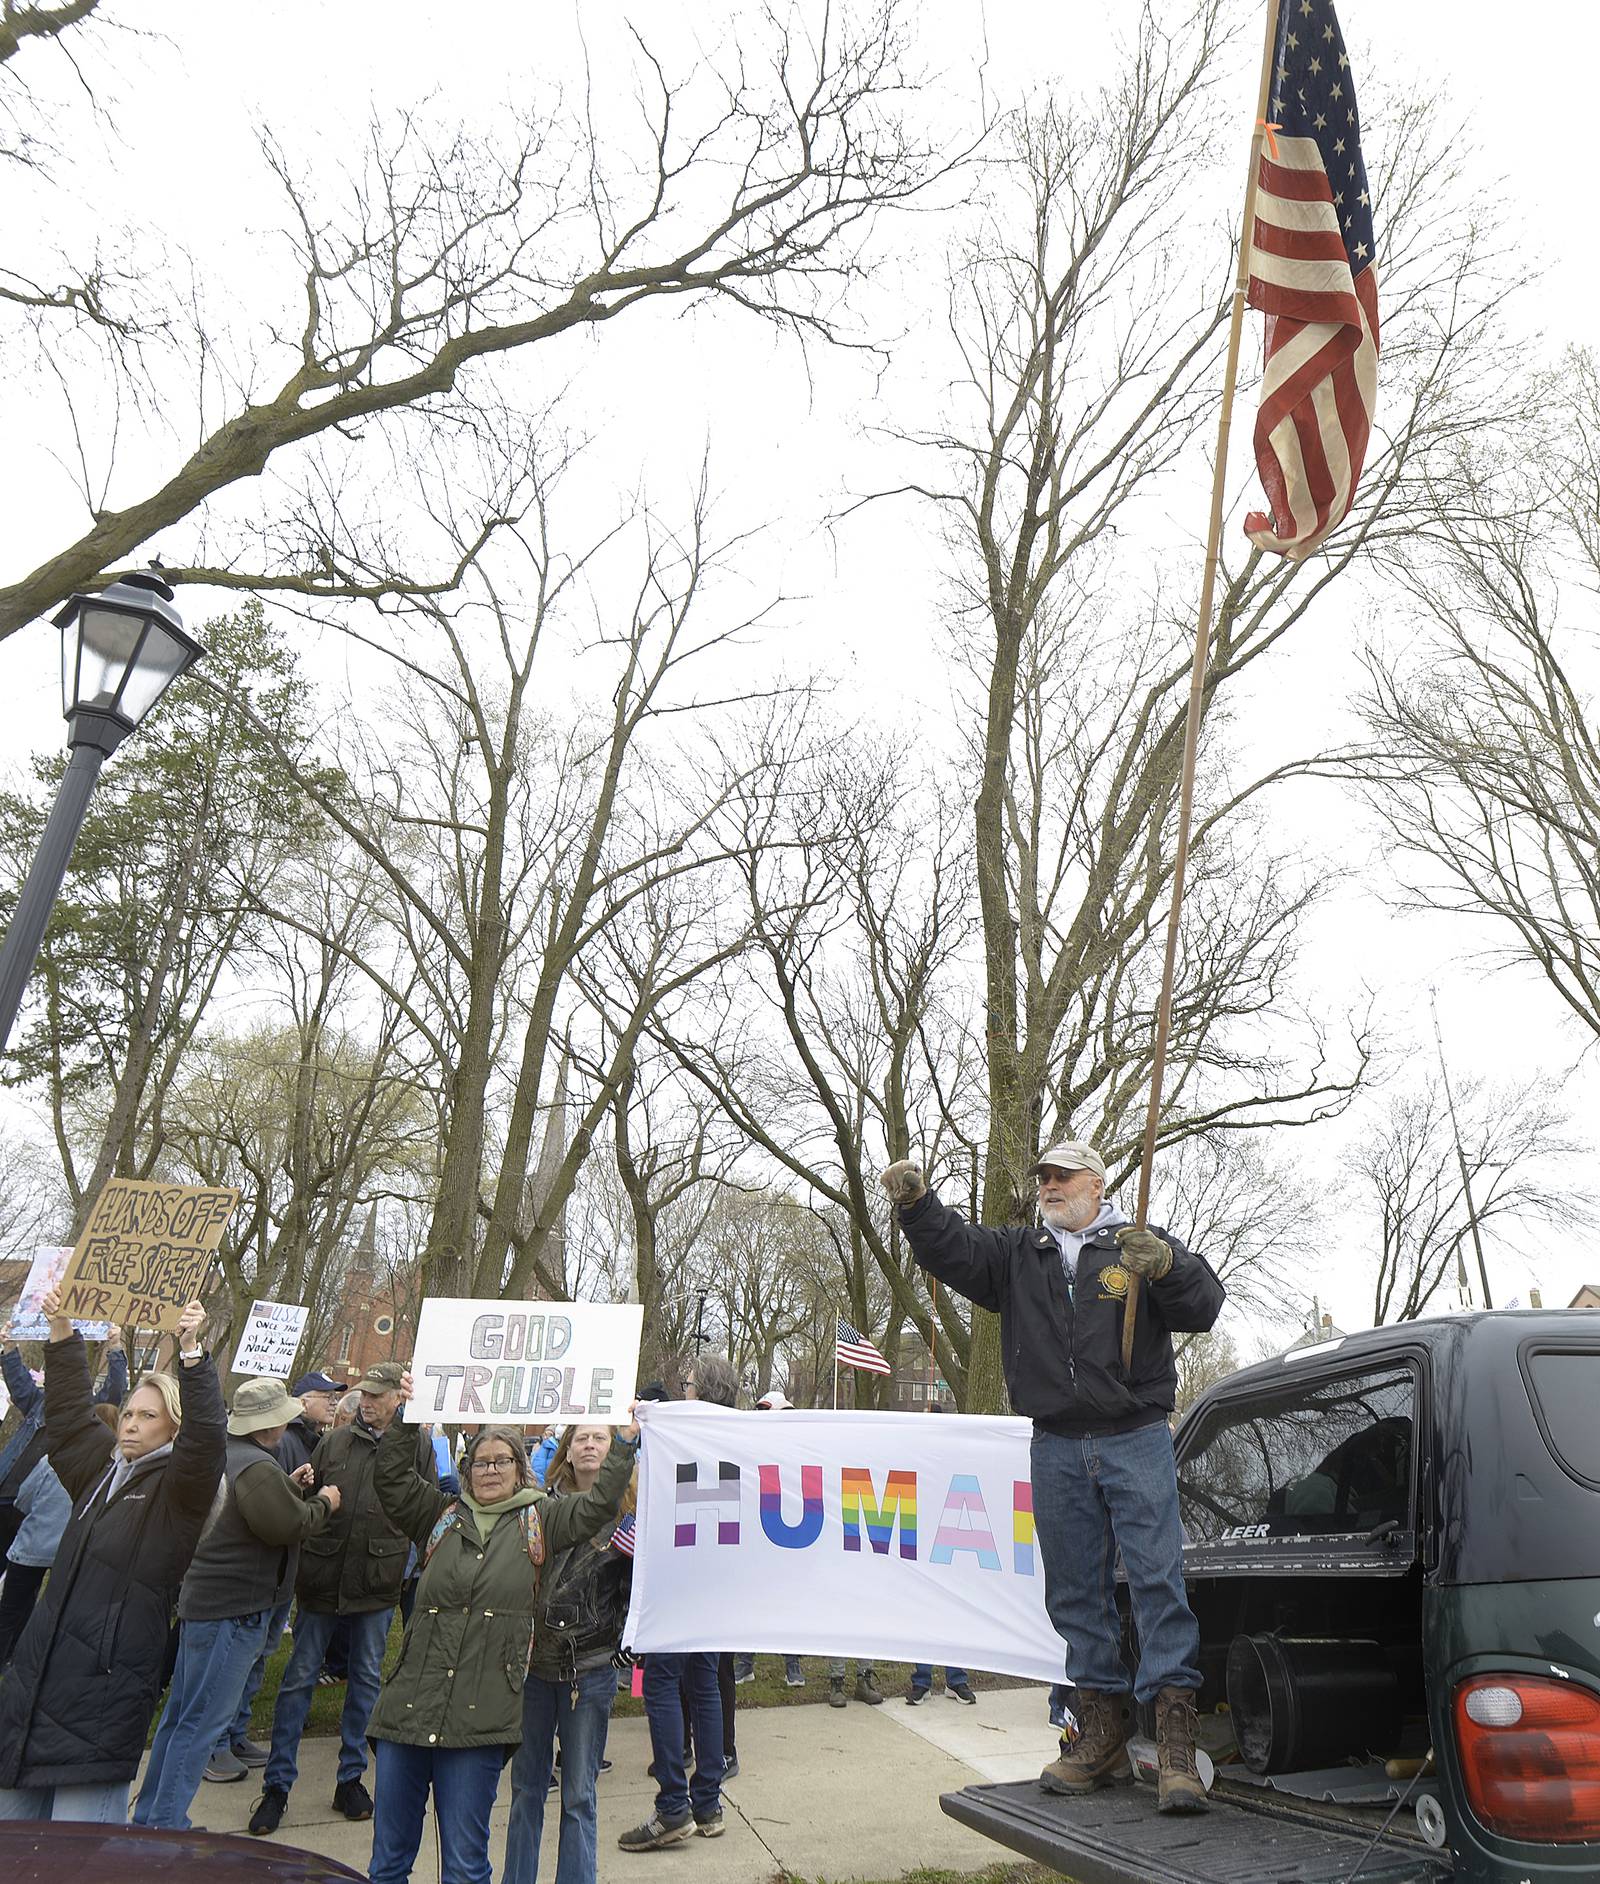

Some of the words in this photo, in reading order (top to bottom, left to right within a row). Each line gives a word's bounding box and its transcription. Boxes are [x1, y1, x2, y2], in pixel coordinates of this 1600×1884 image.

[91, 1187, 183, 1237] HANDS
[170, 1193, 233, 1244] OFF
[74, 1235, 143, 1285] FREE
[128, 1242, 215, 1307] SPEECH
[63, 1283, 112, 1316] NPR
[124, 1297, 166, 1325] PBS
[255, 1320, 278, 1330] ONCE
[271, 1306, 300, 1324] USA
[244, 1343, 270, 1353] NOW
[470, 1314, 572, 1361] GOOD
[425, 1365, 614, 1415] TROUBLE
[1221, 1523, 1271, 1540] LEER
